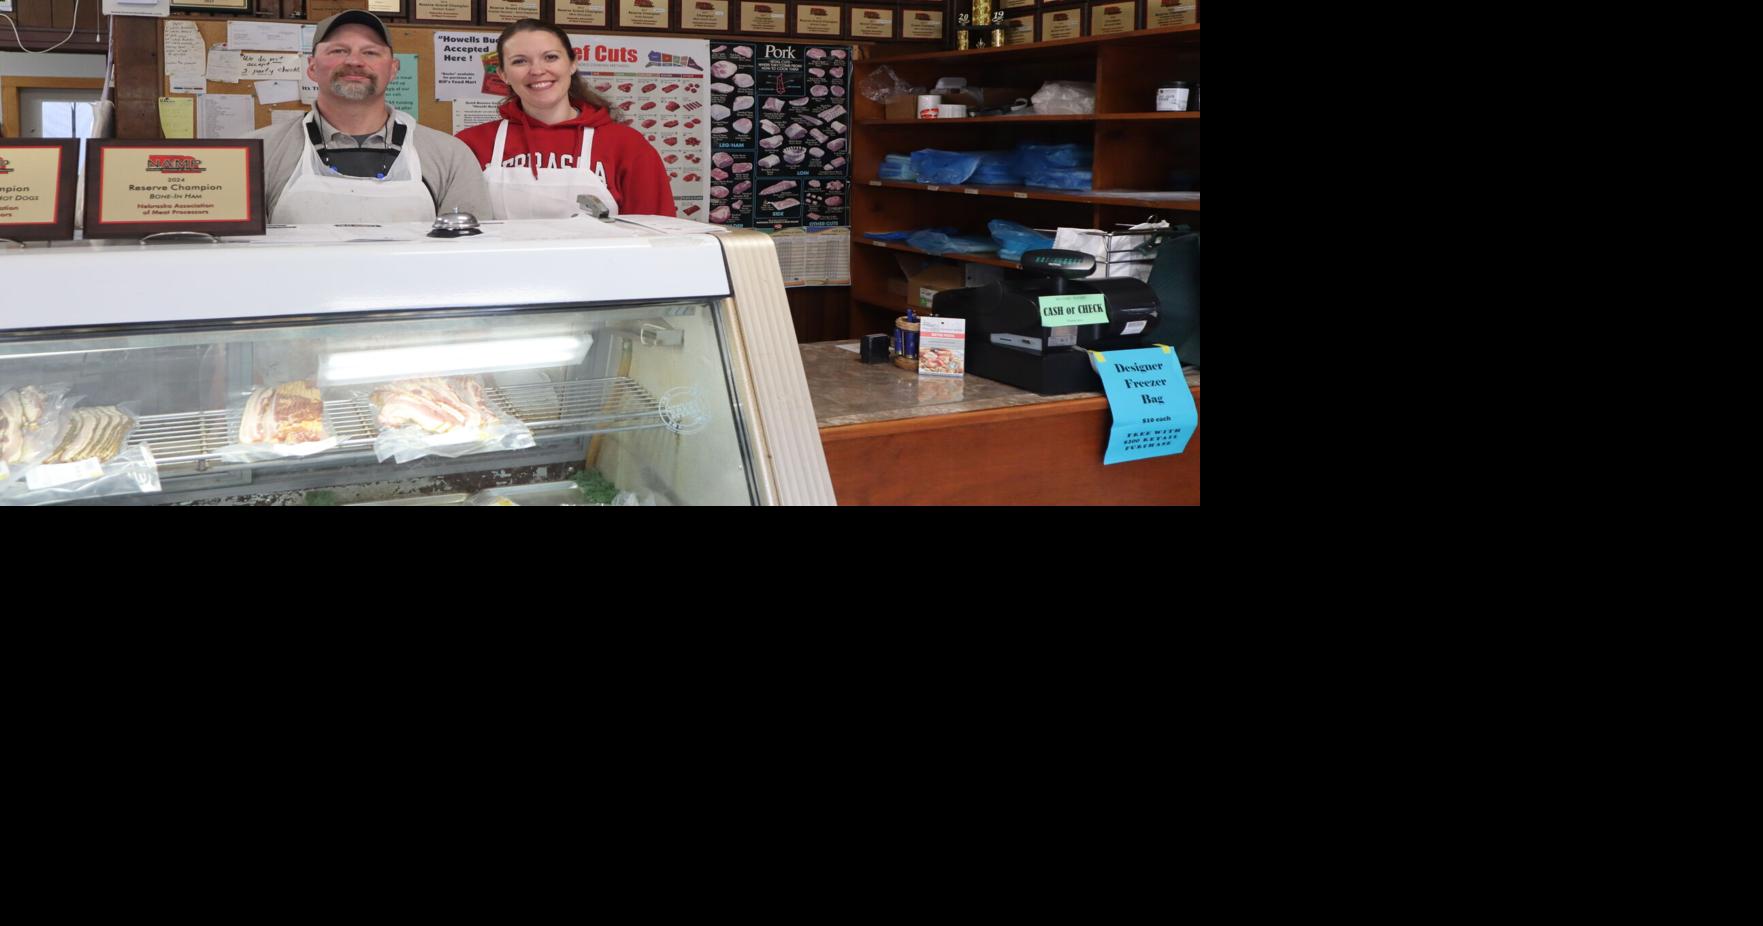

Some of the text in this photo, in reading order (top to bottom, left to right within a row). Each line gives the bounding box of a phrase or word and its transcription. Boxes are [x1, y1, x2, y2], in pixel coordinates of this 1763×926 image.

[443, 45, 490, 53] Accepted
[594, 44, 638, 63] Cuts
[764, 44, 796, 59] Pork
[443, 54, 469, 62] Here
[147, 159, 203, 169] NAMP
[485, 152, 607, 185] BRASA
[170, 184, 223, 192] Champion
[1043, 303, 1104, 317] CASH or CHECK
[1114, 361, 1163, 373] Designer
[1124, 378, 1167, 389] Freezer
[1141, 393, 1165, 405] Bag
[1155, 415, 1172, 423] each
[1125, 441, 1171, 451] PURCHASE
